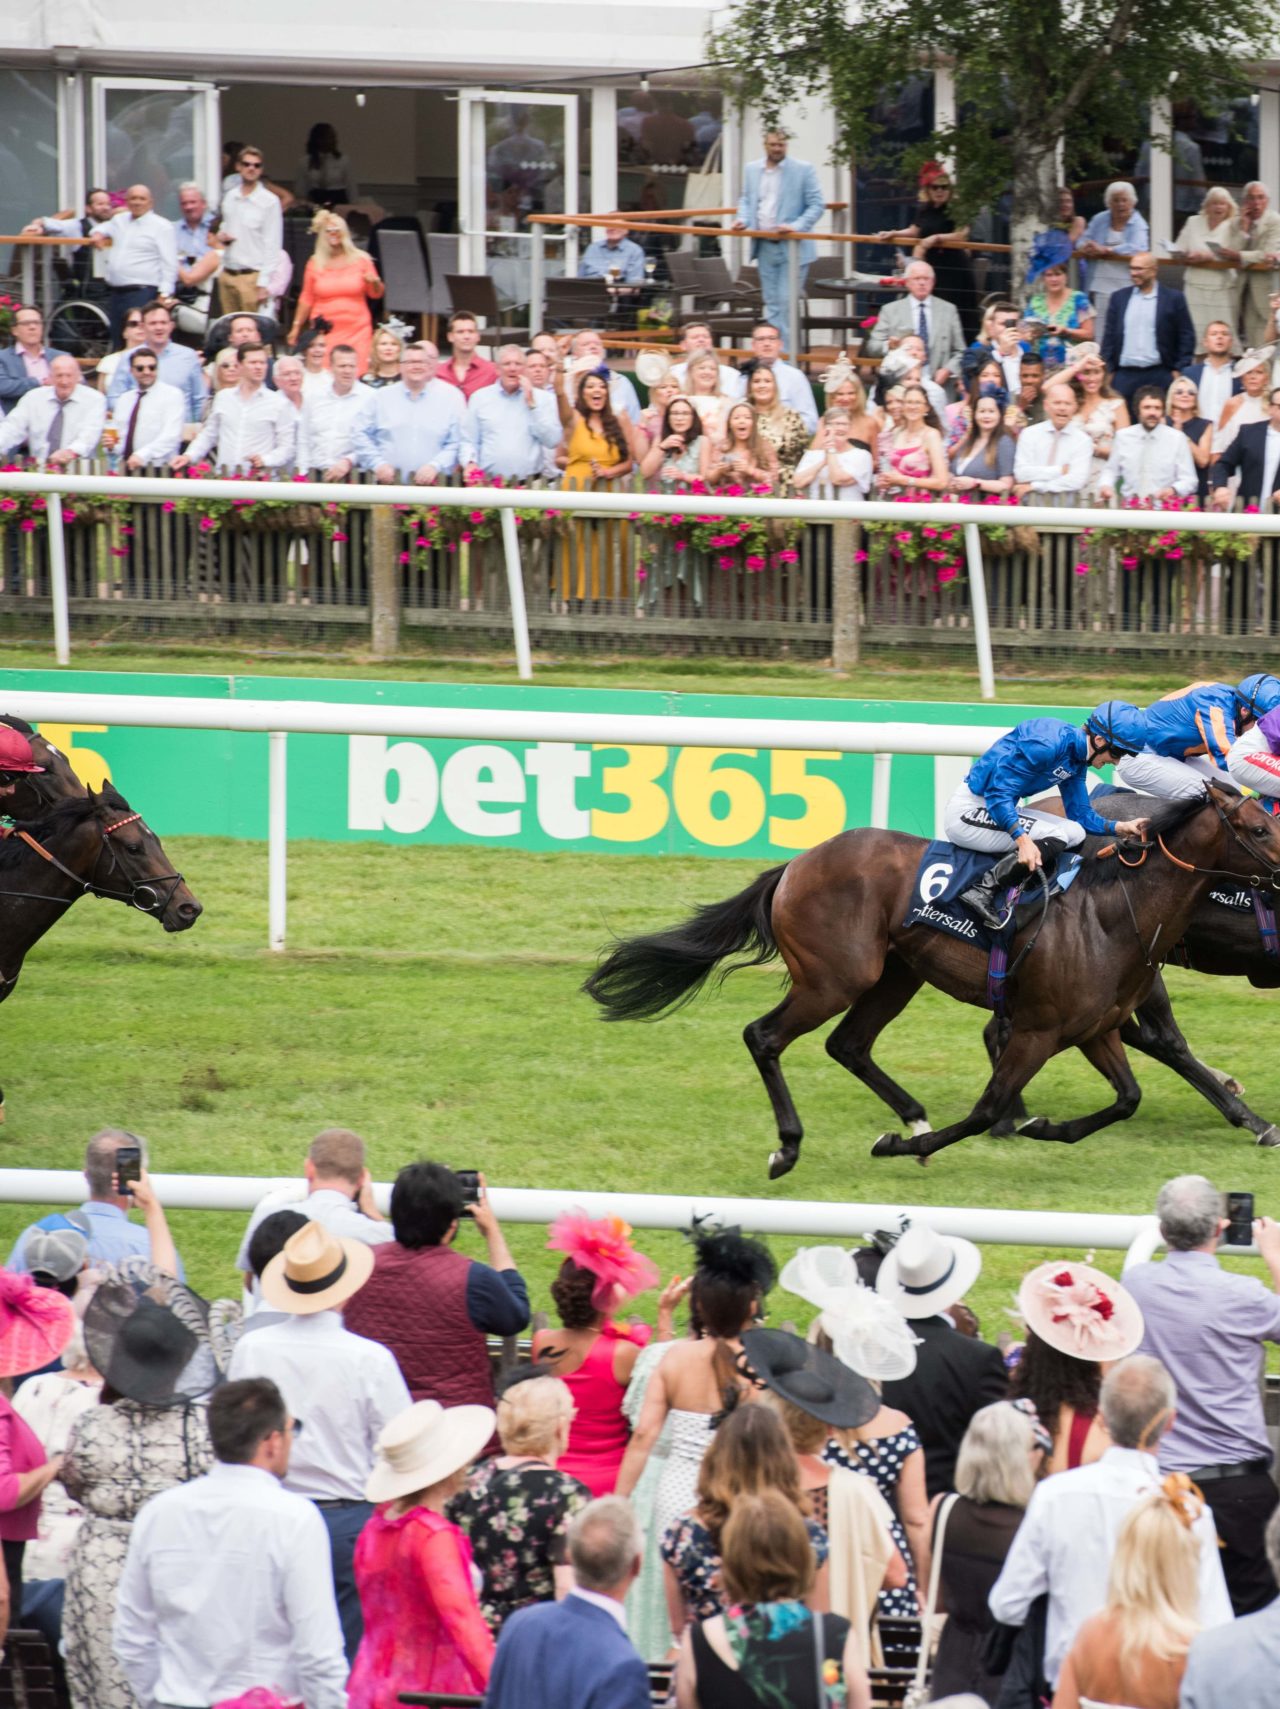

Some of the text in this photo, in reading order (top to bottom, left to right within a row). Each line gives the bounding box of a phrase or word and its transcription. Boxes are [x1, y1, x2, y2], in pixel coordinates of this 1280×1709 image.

[348, 735, 847, 849] bet365
[919, 862, 954, 904] 6
[1209, 891, 1252, 908] rsalls
